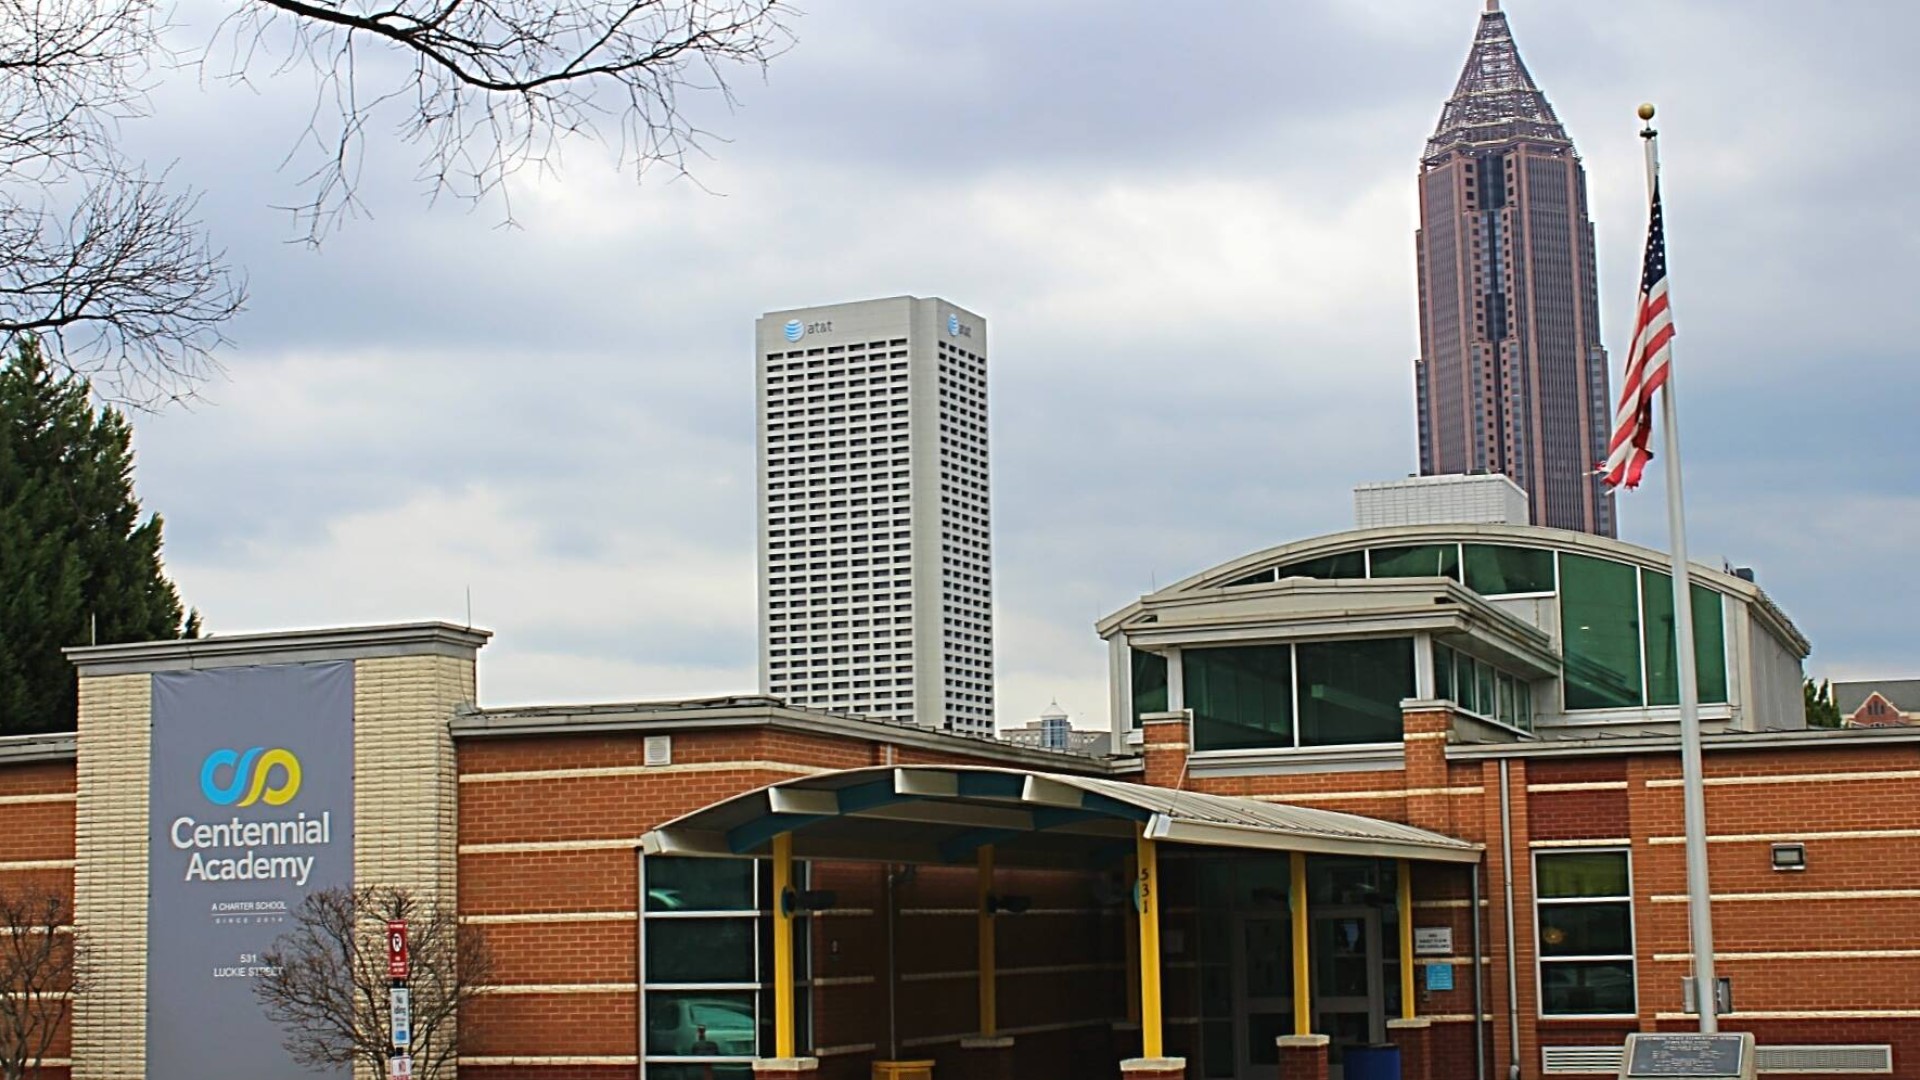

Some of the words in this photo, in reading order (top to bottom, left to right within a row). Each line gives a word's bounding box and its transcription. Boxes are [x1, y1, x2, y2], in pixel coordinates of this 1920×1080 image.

[171, 811, 330, 849] Centennial
[184, 850, 315, 886] Academy
[1140, 868, 1149, 914] 531
[211, 903, 218, 911] A
[219, 902, 254, 911] CHARTER
[255, 901, 287, 910] SCHOOL
[240, 953, 257, 963] 531
[213, 967, 246, 977] LUCKIE
